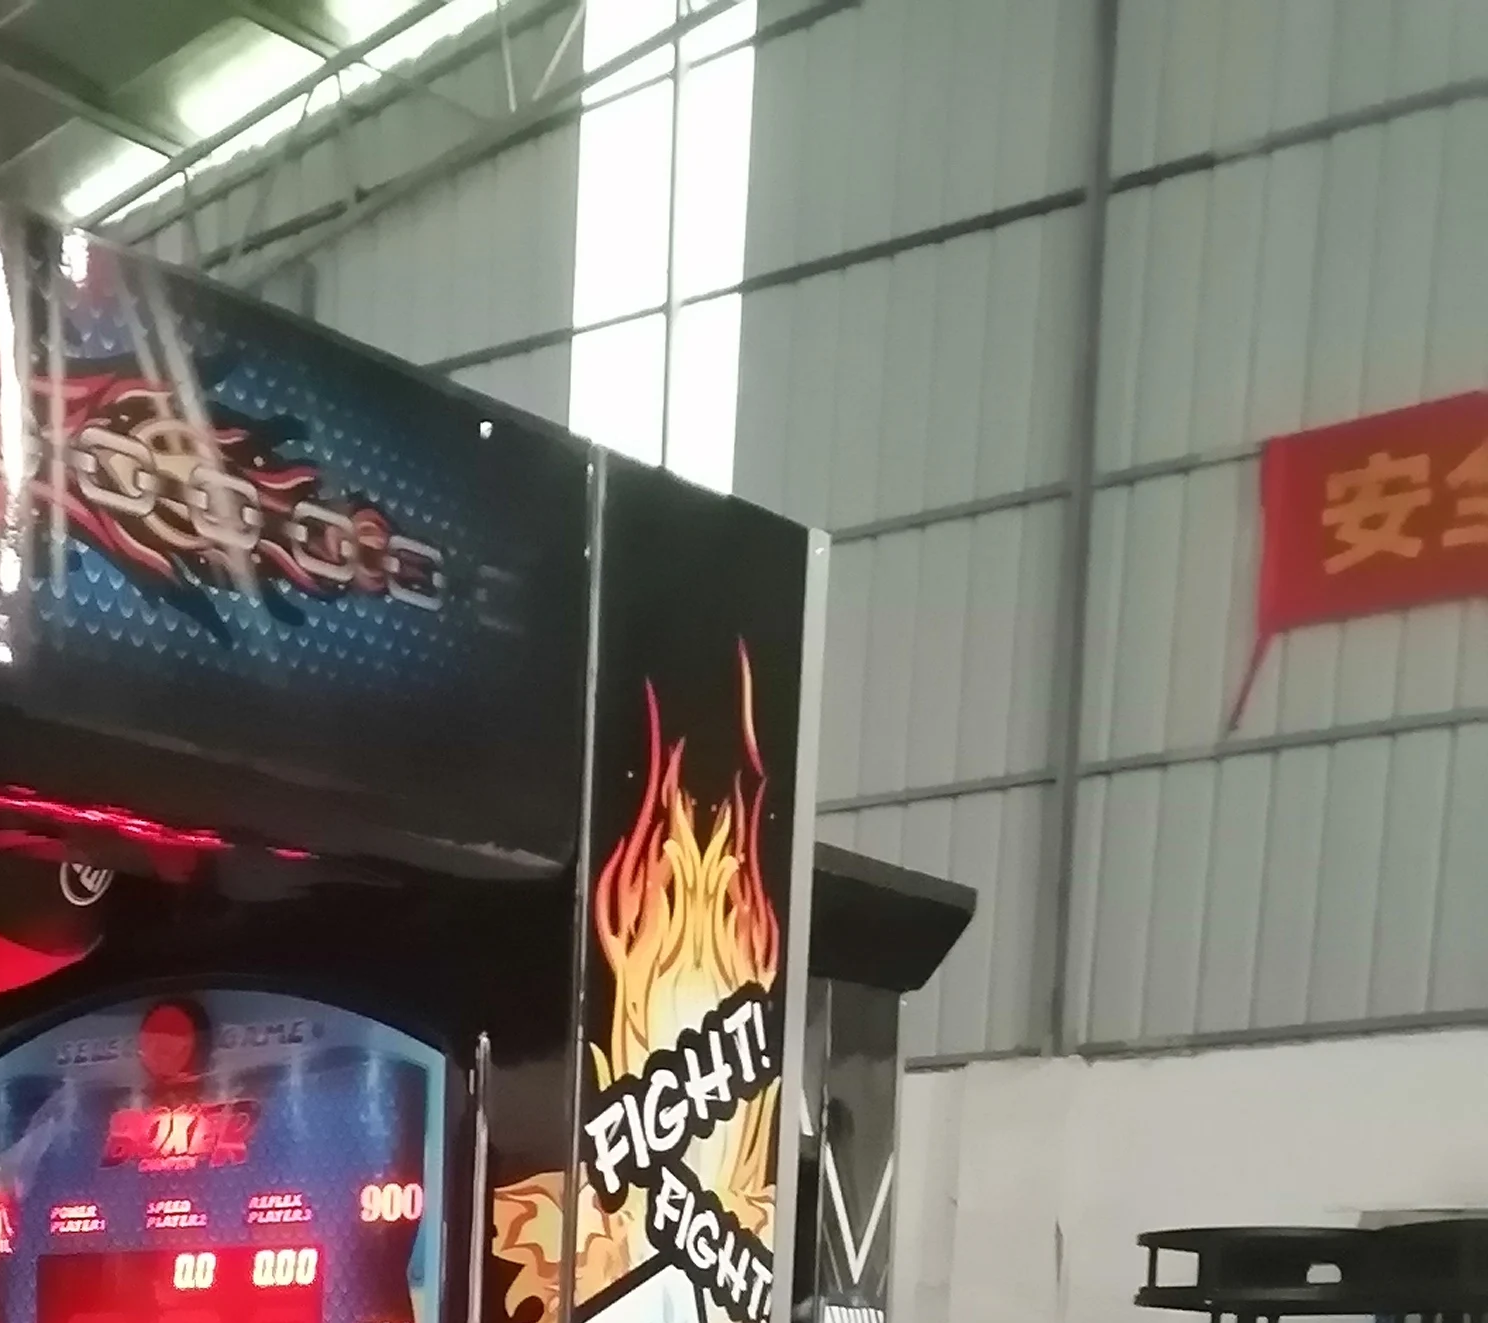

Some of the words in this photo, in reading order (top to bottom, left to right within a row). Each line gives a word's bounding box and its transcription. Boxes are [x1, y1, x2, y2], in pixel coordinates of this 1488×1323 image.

[584, 1000, 771, 1193] FIGHT!
[146, 1199, 192, 1214] SPEED
[360, 1183, 423, 1222] 900
